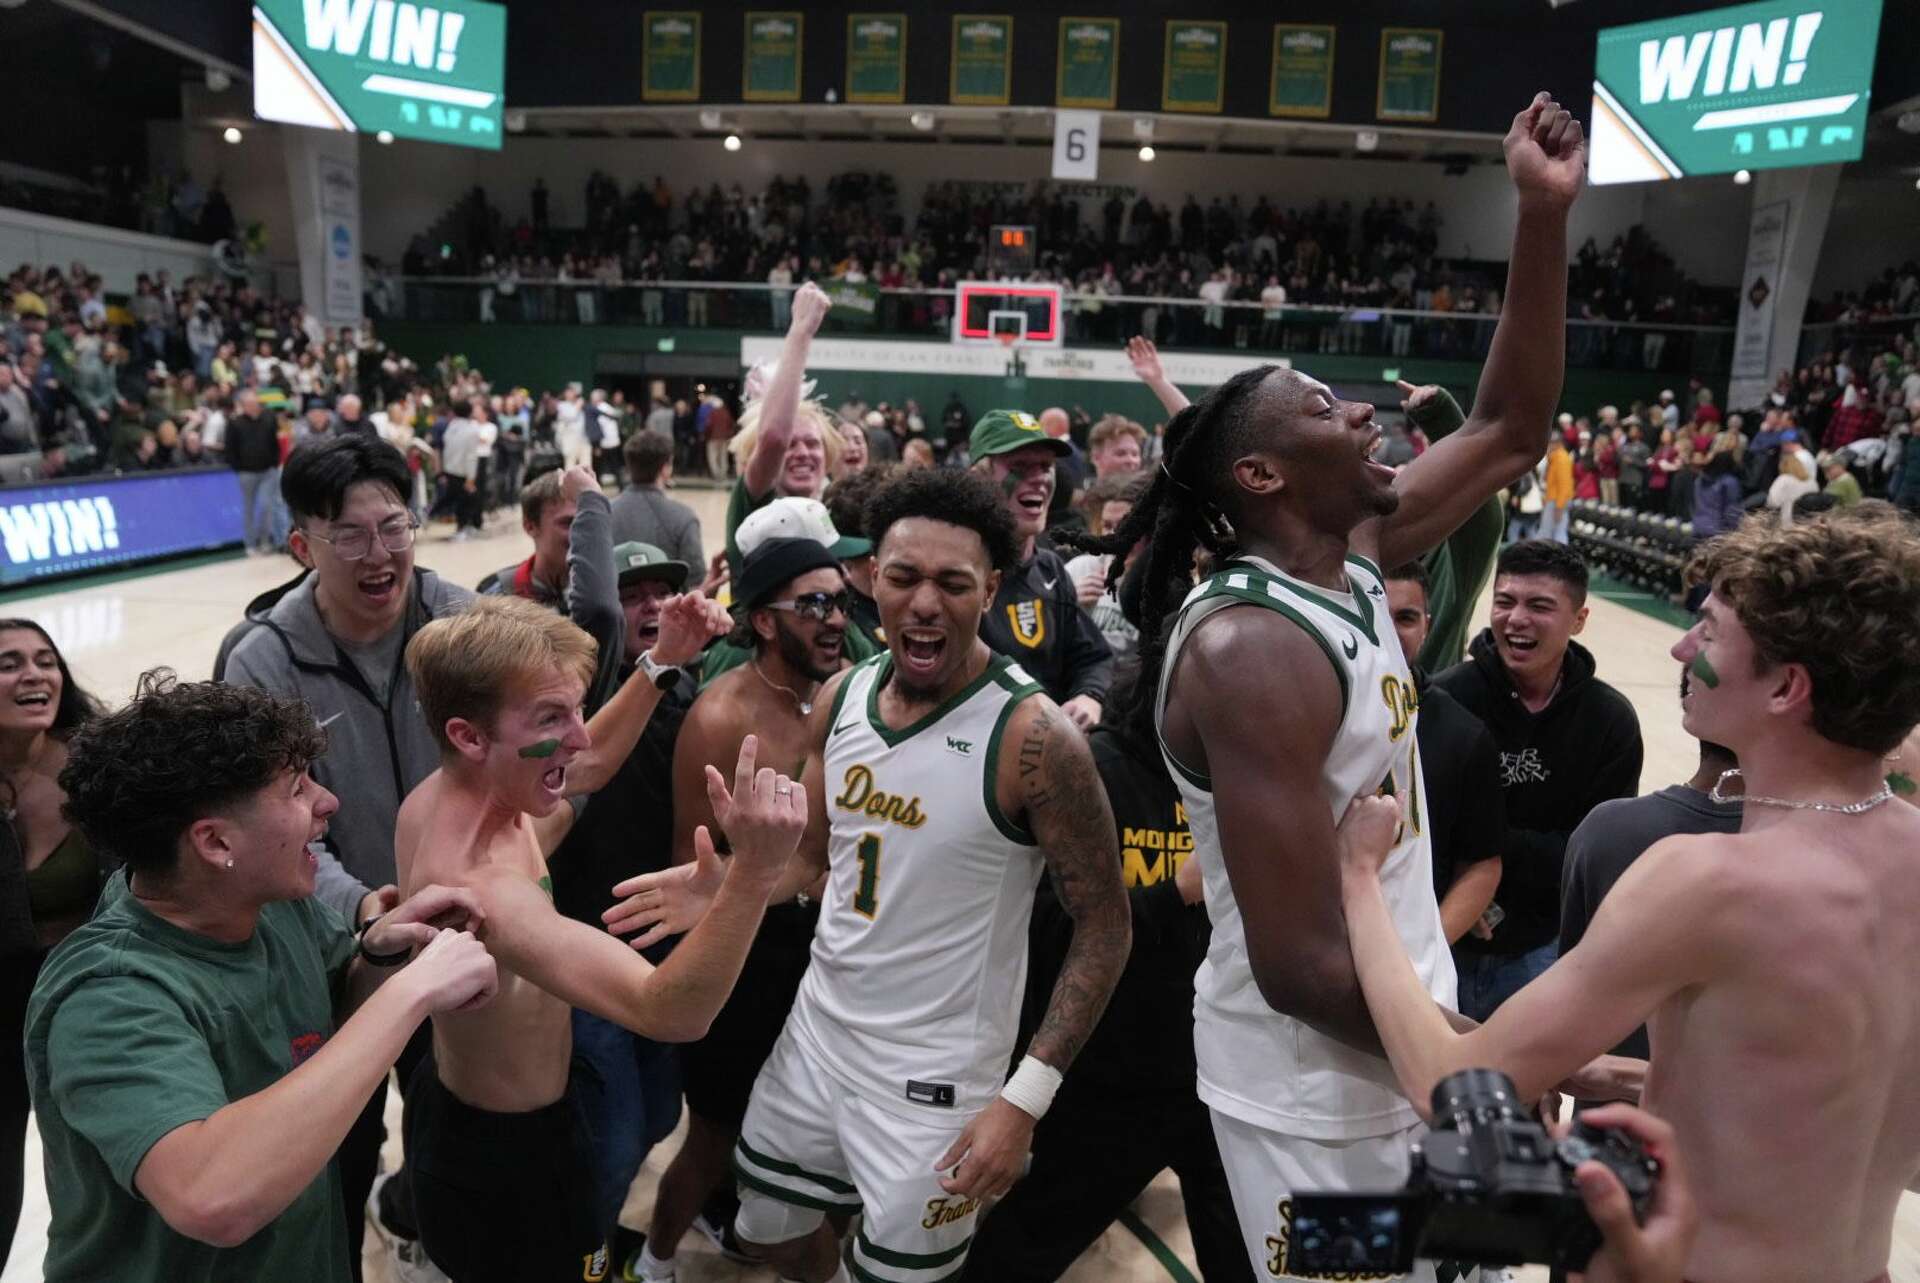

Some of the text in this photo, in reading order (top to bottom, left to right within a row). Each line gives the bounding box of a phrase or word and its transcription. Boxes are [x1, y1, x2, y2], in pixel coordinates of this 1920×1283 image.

[303, 0, 465, 72] WIN!
[1640, 12, 1823, 104] WIN!
[1066, 128, 1087, 162] 6
[0, 496, 120, 564] WIN!
[834, 763, 928, 829] Dons
[852, 831, 884, 922] 1
